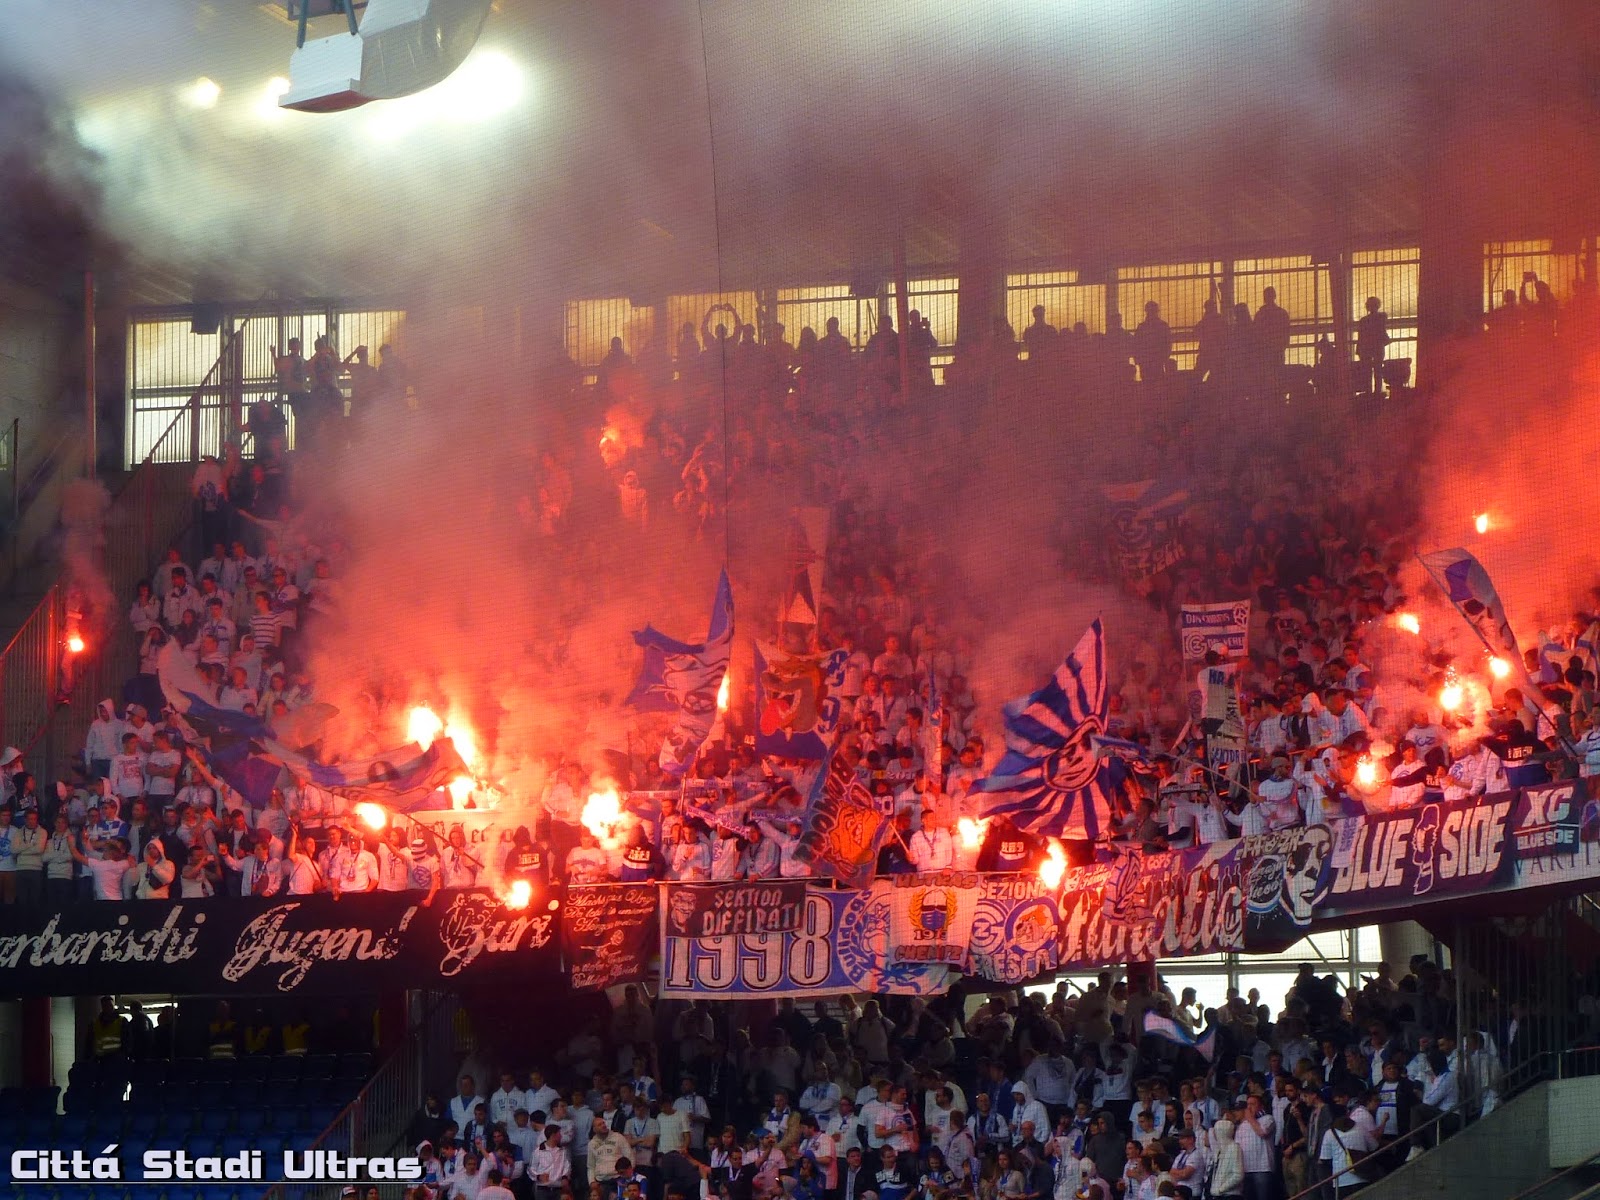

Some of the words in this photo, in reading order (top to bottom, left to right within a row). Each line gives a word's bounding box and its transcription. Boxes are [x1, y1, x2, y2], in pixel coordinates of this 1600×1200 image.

[1439, 800, 1513, 880] SIDE
[895, 872, 979, 890] ULTRAS
[666, 893, 835, 990] 1998
